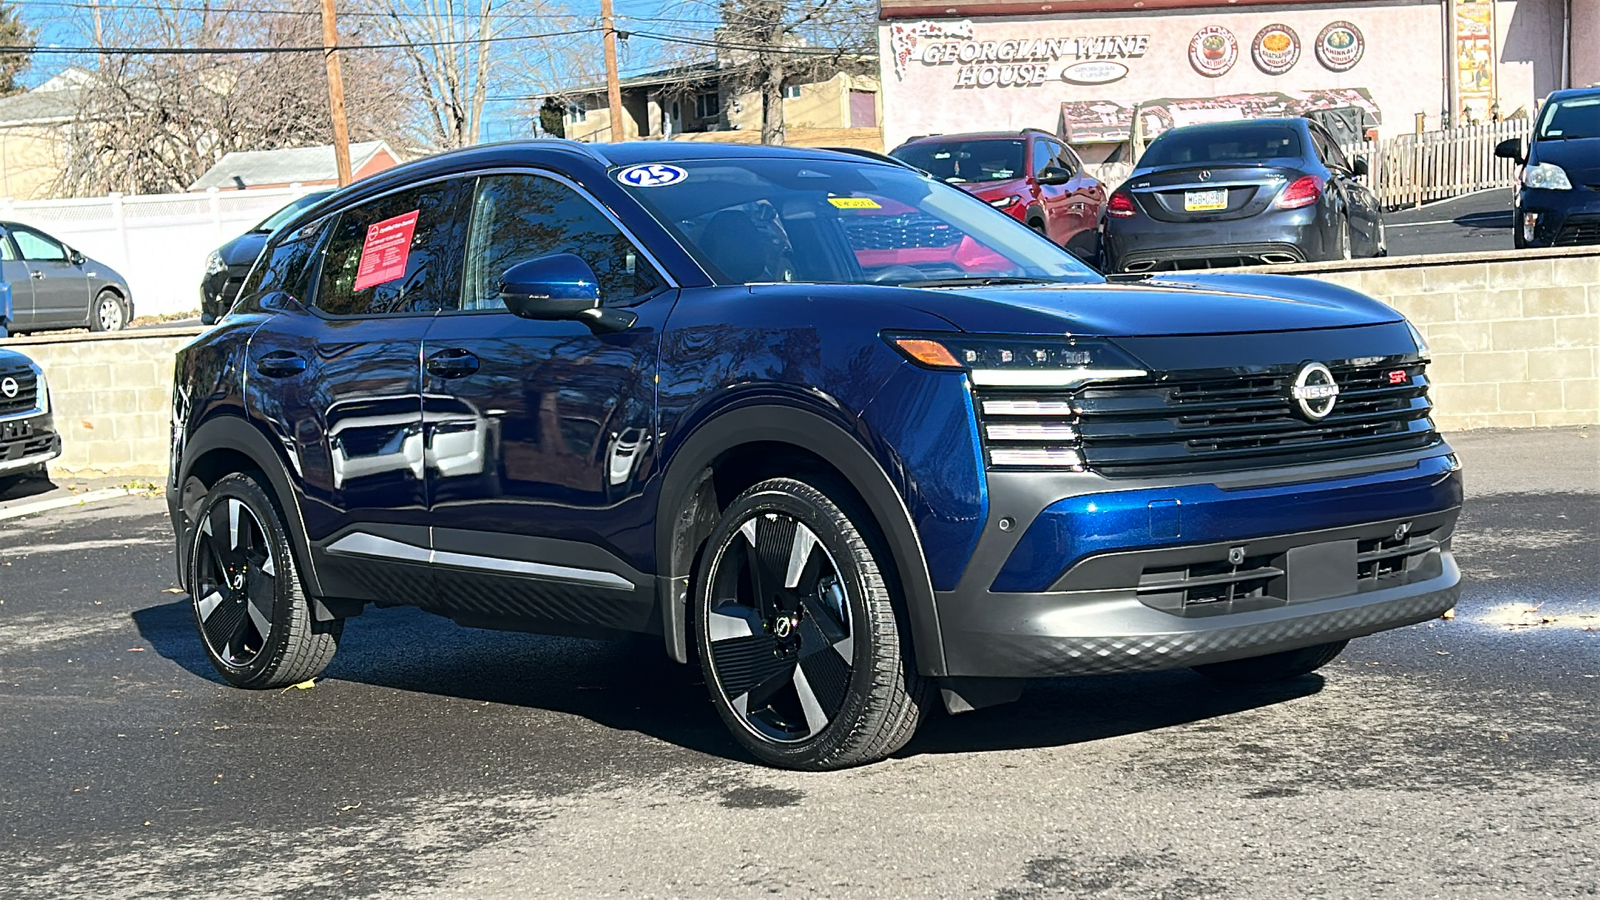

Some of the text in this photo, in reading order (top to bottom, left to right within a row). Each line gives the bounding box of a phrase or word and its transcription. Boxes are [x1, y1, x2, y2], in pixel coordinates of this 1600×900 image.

[922, 35, 1150, 65] GEORGIAN WINE
[956, 64, 1049, 87] HOUSE
[630, 166, 675, 186] 25
[1388, 369, 1407, 384] SR
[1295, 385, 1340, 399] NISSAN
